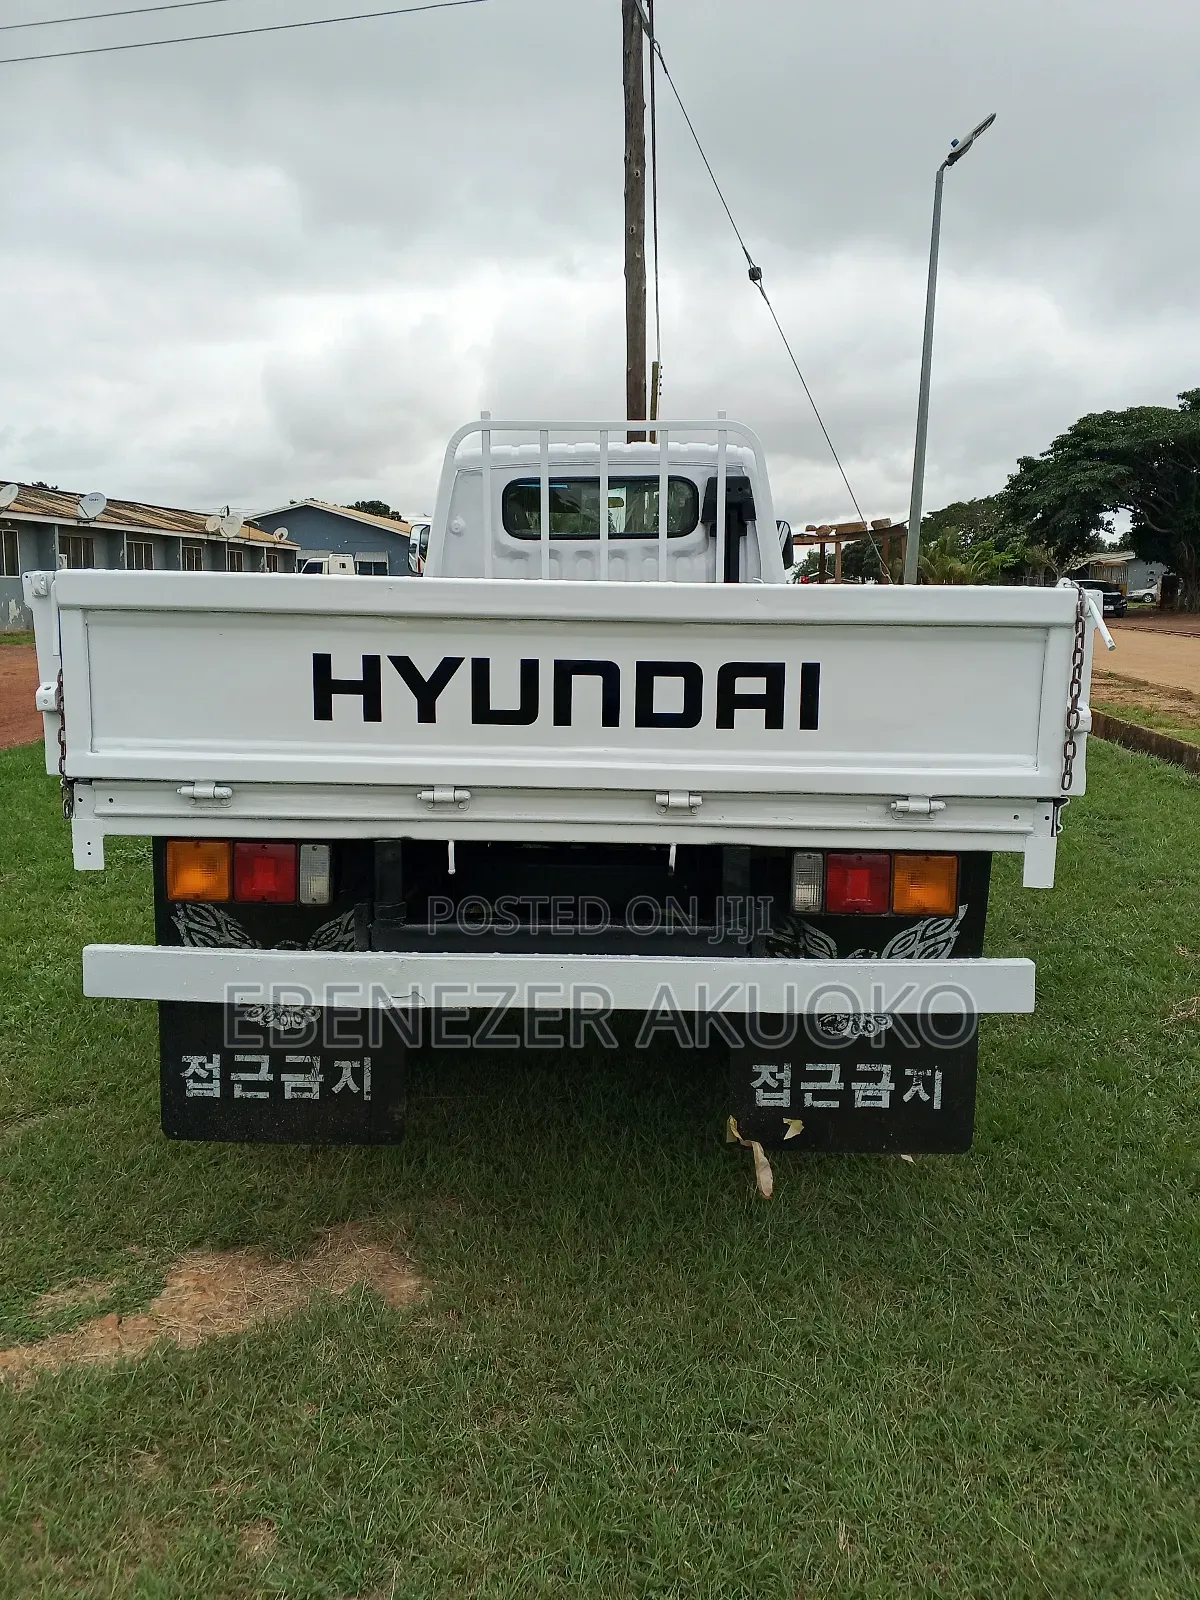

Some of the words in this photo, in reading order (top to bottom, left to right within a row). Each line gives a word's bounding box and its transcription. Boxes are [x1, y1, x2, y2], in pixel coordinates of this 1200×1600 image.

[312, 653, 821, 730] HYUNDAI
[179, 1053, 372, 1101] 접근금지
[749, 1062, 943, 1110] 접근금지
